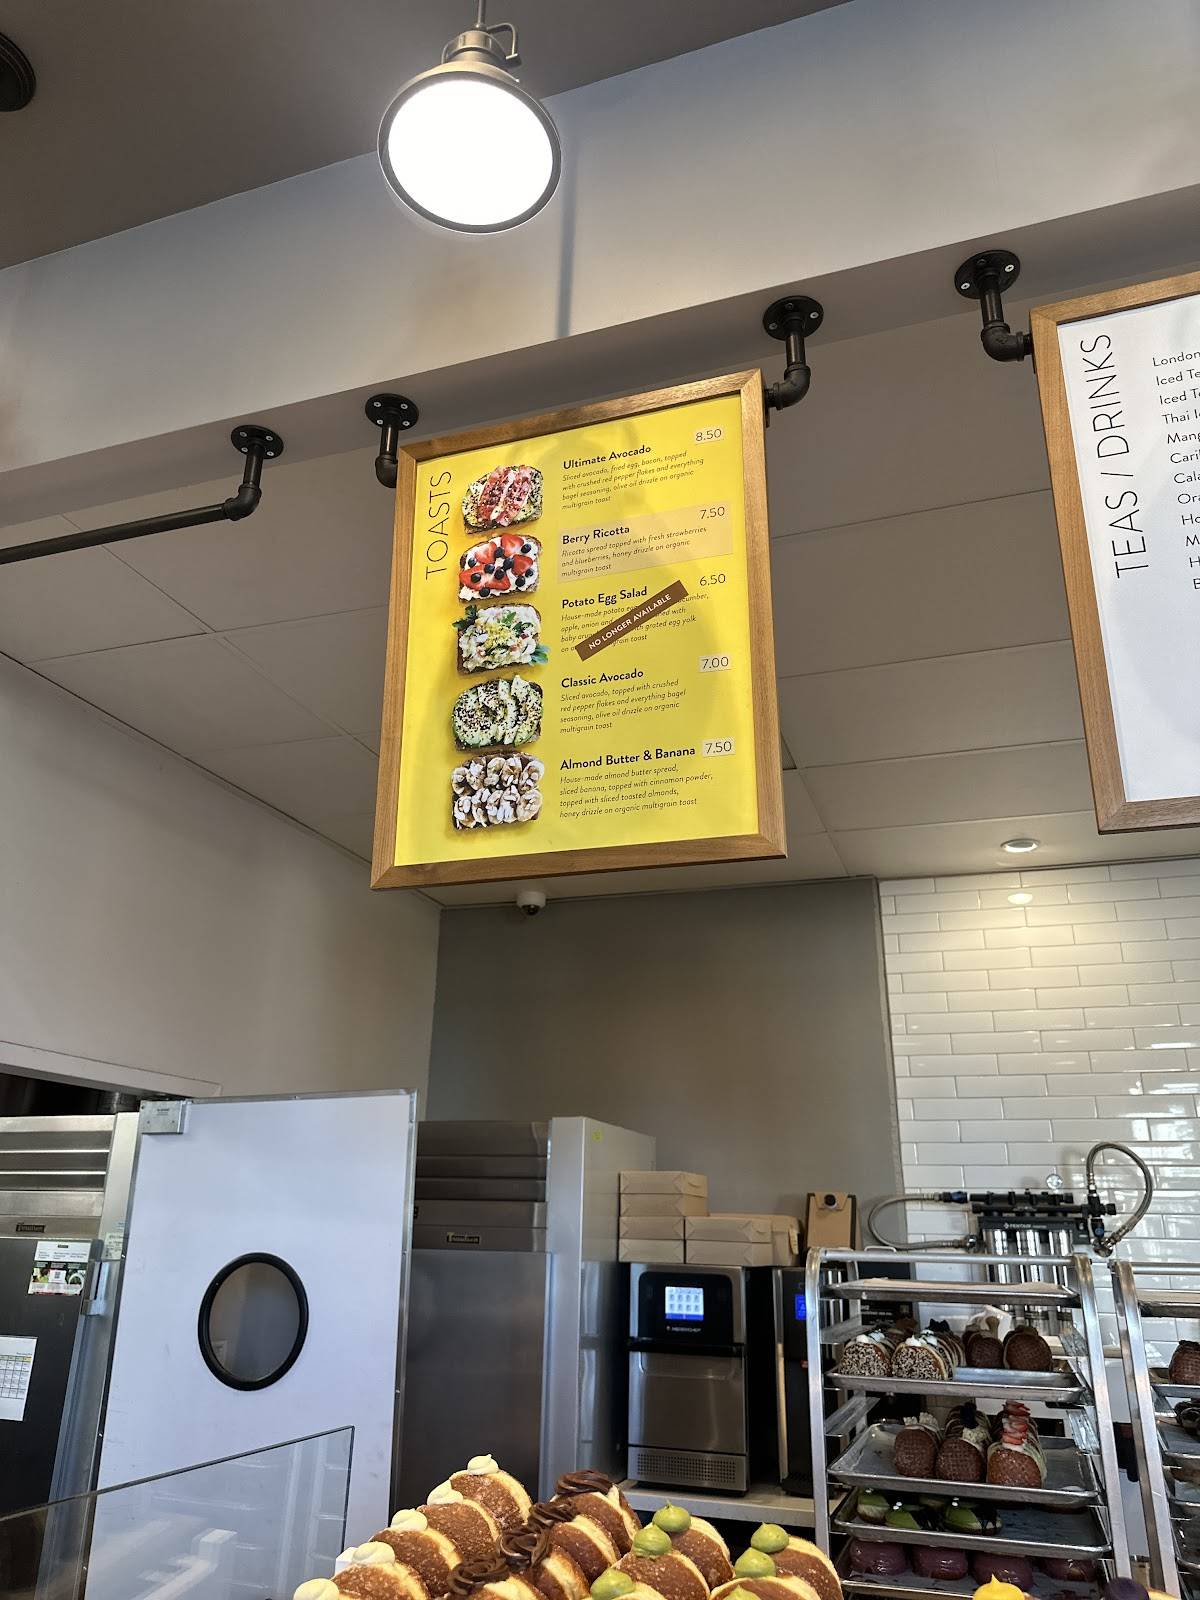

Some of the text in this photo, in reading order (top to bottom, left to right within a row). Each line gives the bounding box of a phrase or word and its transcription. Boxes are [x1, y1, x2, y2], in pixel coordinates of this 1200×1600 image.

[1152, 352, 1200, 367] London
[1156, 371, 1183, 386] Iced
[1080, 334, 1130, 459] DRINKS
[1159, 390, 1187, 405] Iced
[1161, 410, 1190, 424] Thai
[695, 428, 722, 442] 8.50
[562, 472, 581, 482] Sliced
[610, 462, 626, 475] fried
[664, 451, 688, 462] topped
[563, 445, 651, 470] Ultimate Avocado
[562, 457, 704, 491] with crushed red pepper flakes and everything
[562, 492, 579, 501] bagel
[613, 481, 627, 491] olive
[628, 480, 638, 488] oil
[638, 475, 658, 486] drizzle
[669, 470, 695, 481] organic
[561, 495, 612, 510] multigrain toast
[700, 506, 726, 520] 7.50
[425, 471, 452, 581] TOASTS
[562, 525, 630, 545] Berry Ricotta
[1104, 490, 1149, 578] TEAS
[561, 526, 707, 558] Ricotta spread topped with fresh strawberries
[561, 559, 574, 567] and
[612, 549, 632, 561] honey
[632, 545, 654, 555] drizzle
[665, 539, 690, 551] organic
[561, 564, 612, 578] multigrain toast
[699, 573, 726, 587] 6.50
[562, 586, 648, 609] Potato Egg Salad
[603, 606, 625, 617] potato
[671, 607, 687, 615] with
[581, 620, 599, 629] onion
[600, 619, 614, 627] and
[588, 638, 602, 650] NO
[601, 618, 633, 642] LONGER
[632, 593, 672, 622] AVAILABLE
[645, 621, 667, 632] grated
[668, 619, 680, 628] egg
[681, 615, 697, 625] yolk
[561, 634, 577, 643] baby
[630, 634, 648, 643] toast
[701, 656, 729, 670] 7.00
[561, 668, 644, 689] Classic Avocado
[560, 692, 581, 702] Sliced
[611, 685, 635, 697] topped
[636, 684, 651, 692] with
[652, 679, 680, 690] crushed
[560, 689, 687, 713] red pepper flakes and everything bagel
[595, 709, 611, 719] olive
[611, 708, 621, 717] oil
[621, 705, 643, 715] drizzle
[643, 704, 653, 712] on
[654, 701, 680, 713] organic
[560, 721, 613, 735] multigrain toast
[704, 740, 732, 755] 7.50
[560, 746, 696, 770] Almond Butter & Banana
[604, 769, 630, 780] almond
[631, 767, 653, 777] butter
[560, 787, 579, 796] sliced
[608, 780, 632, 792] topped
[633, 779, 648, 788] with
[649, 776, 684, 786] cinnamon
[560, 797, 583, 808] topped
[584, 795, 599, 804] with
[600, 792, 620, 803] sliced
[621, 790, 647, 801] toasted
[560, 797, 697, 819] honey drizzle on organic multigrain toast
